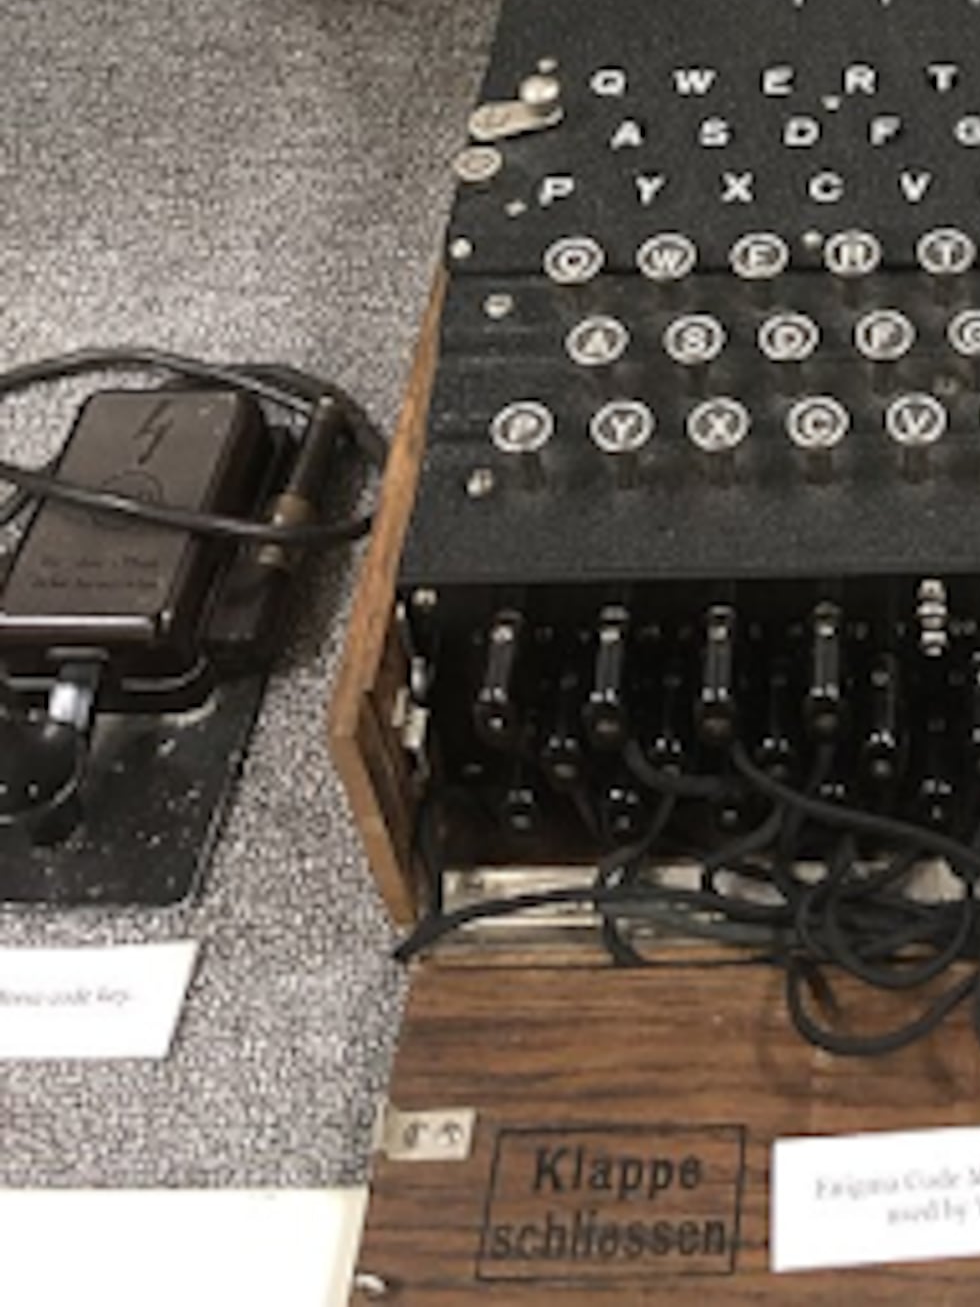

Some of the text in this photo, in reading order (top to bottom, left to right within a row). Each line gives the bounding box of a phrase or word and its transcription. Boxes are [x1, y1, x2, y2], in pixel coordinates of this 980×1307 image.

[590, 69, 625, 96] Q
[674, 69, 717, 94] W
[763, 66, 794, 95] E
[845, 64, 876, 94] R
[927, 64, 958, 91] T
[611, 120, 643, 149] A
[701, 119, 729, 146] S
[784, 117, 819, 146] D
[871, 116, 900, 146] F
[539, 175, 574, 205] P
[636, 175, 664, 204] Y
[722, 172, 753, 202] X
[809, 172, 843, 202] C
[900, 172, 931, 201] V
[533, 1145, 704, 1199] Klappe
[490, 1210, 728, 1261] schliessen
